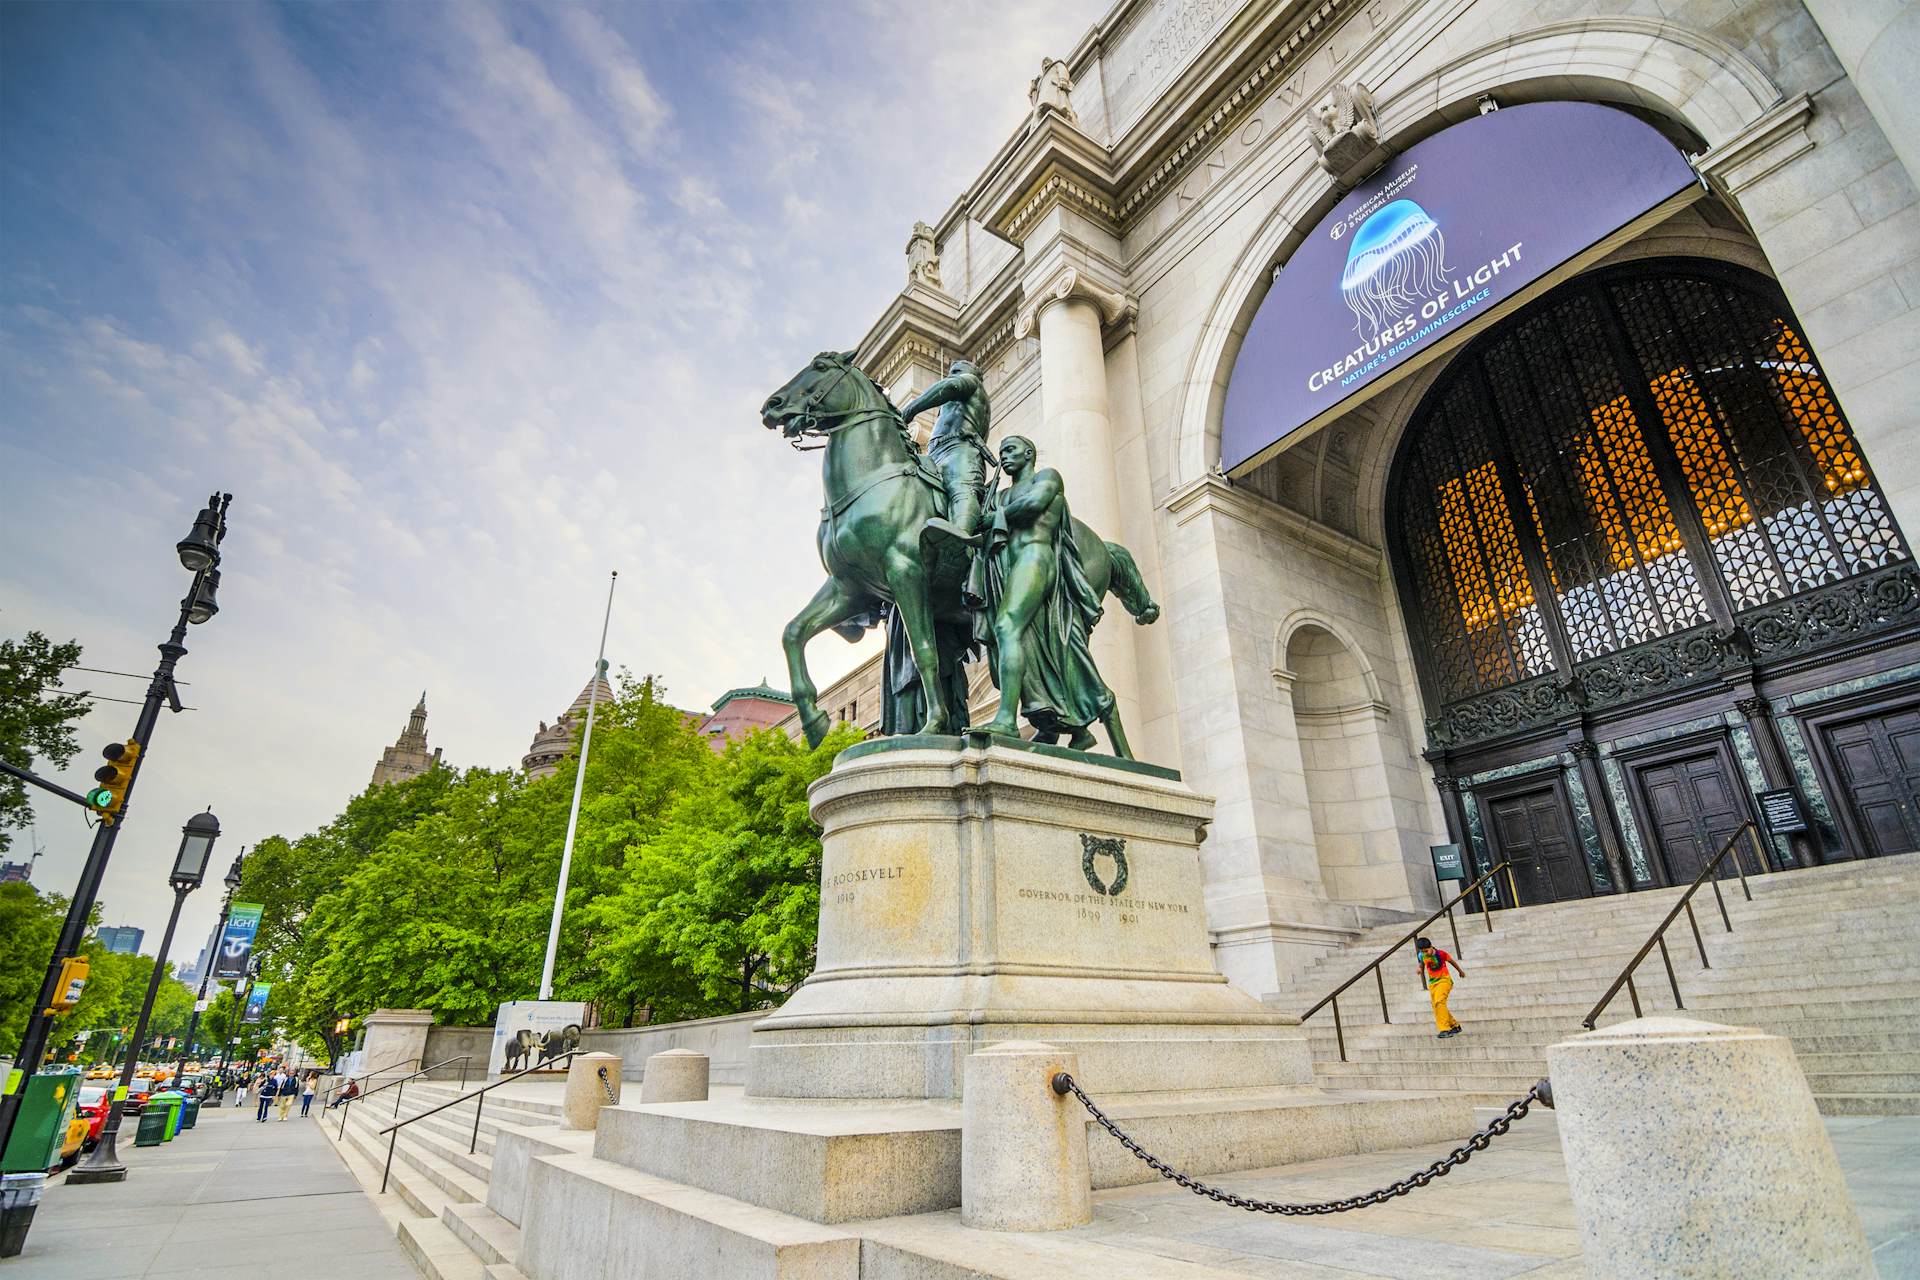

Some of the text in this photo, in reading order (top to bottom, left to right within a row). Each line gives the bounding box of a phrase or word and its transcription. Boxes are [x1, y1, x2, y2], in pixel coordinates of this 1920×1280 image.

[1347, 164, 1418, 221] AMERICAN MUSEUM
[1354, 197, 1387, 223] NATURAL
[1386, 173, 1417, 199] HISTORY
[1308, 242, 1523, 391] CREATURES OF LIGHT
[1341, 287, 1491, 387] NATURE'S BIOLUMINESCENCE
[833, 867, 904, 886] ROOSEVELT
[1019, 889, 1188, 913] GOVERNOR OF THE STATE OF NEW YORK
[229, 919, 257, 928] LIGHT
